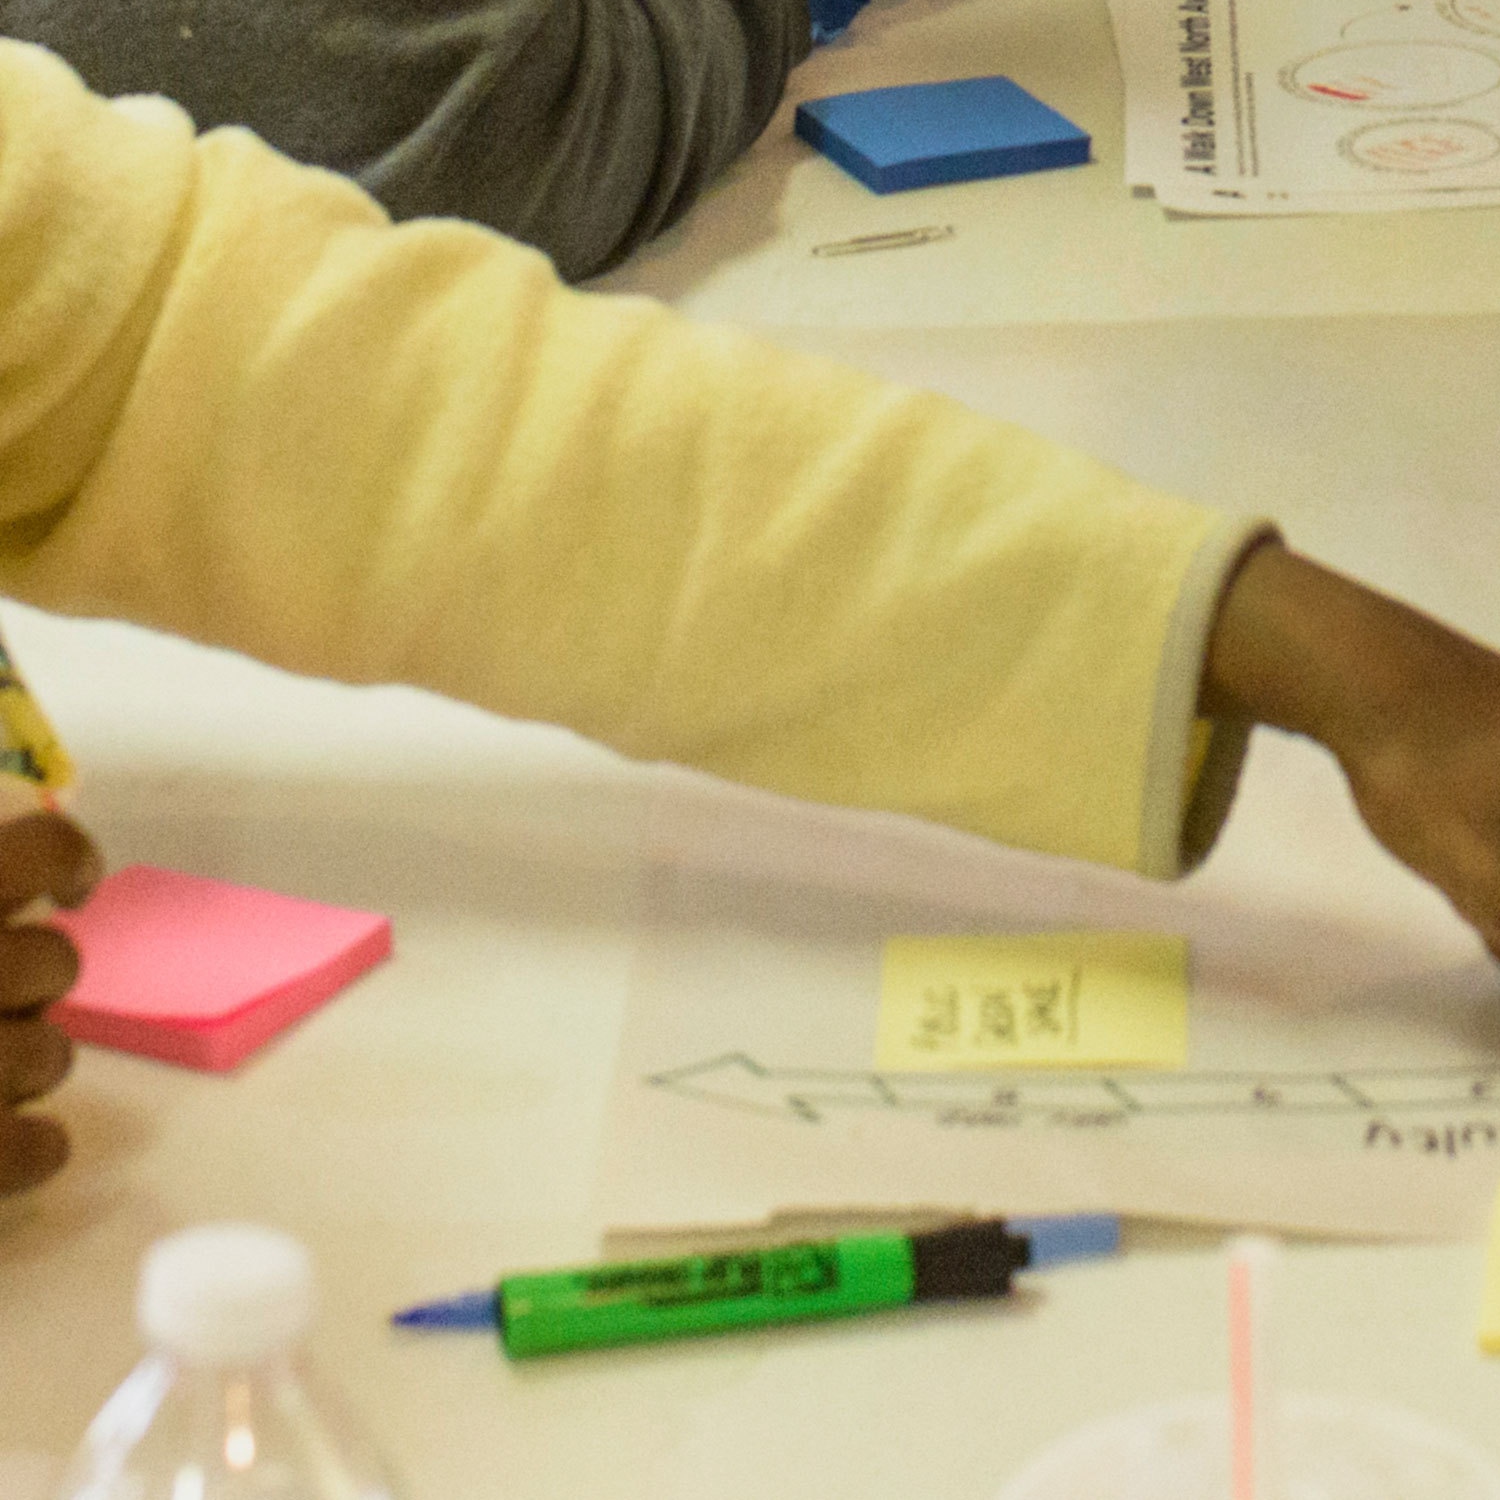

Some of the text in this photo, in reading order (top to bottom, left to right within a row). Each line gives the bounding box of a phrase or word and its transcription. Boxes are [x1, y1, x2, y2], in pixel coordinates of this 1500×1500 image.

[1178, 16, 1212, 54] North
[1178, 56, 1213, 89] West
[1180, 90, 1216, 128] Down
